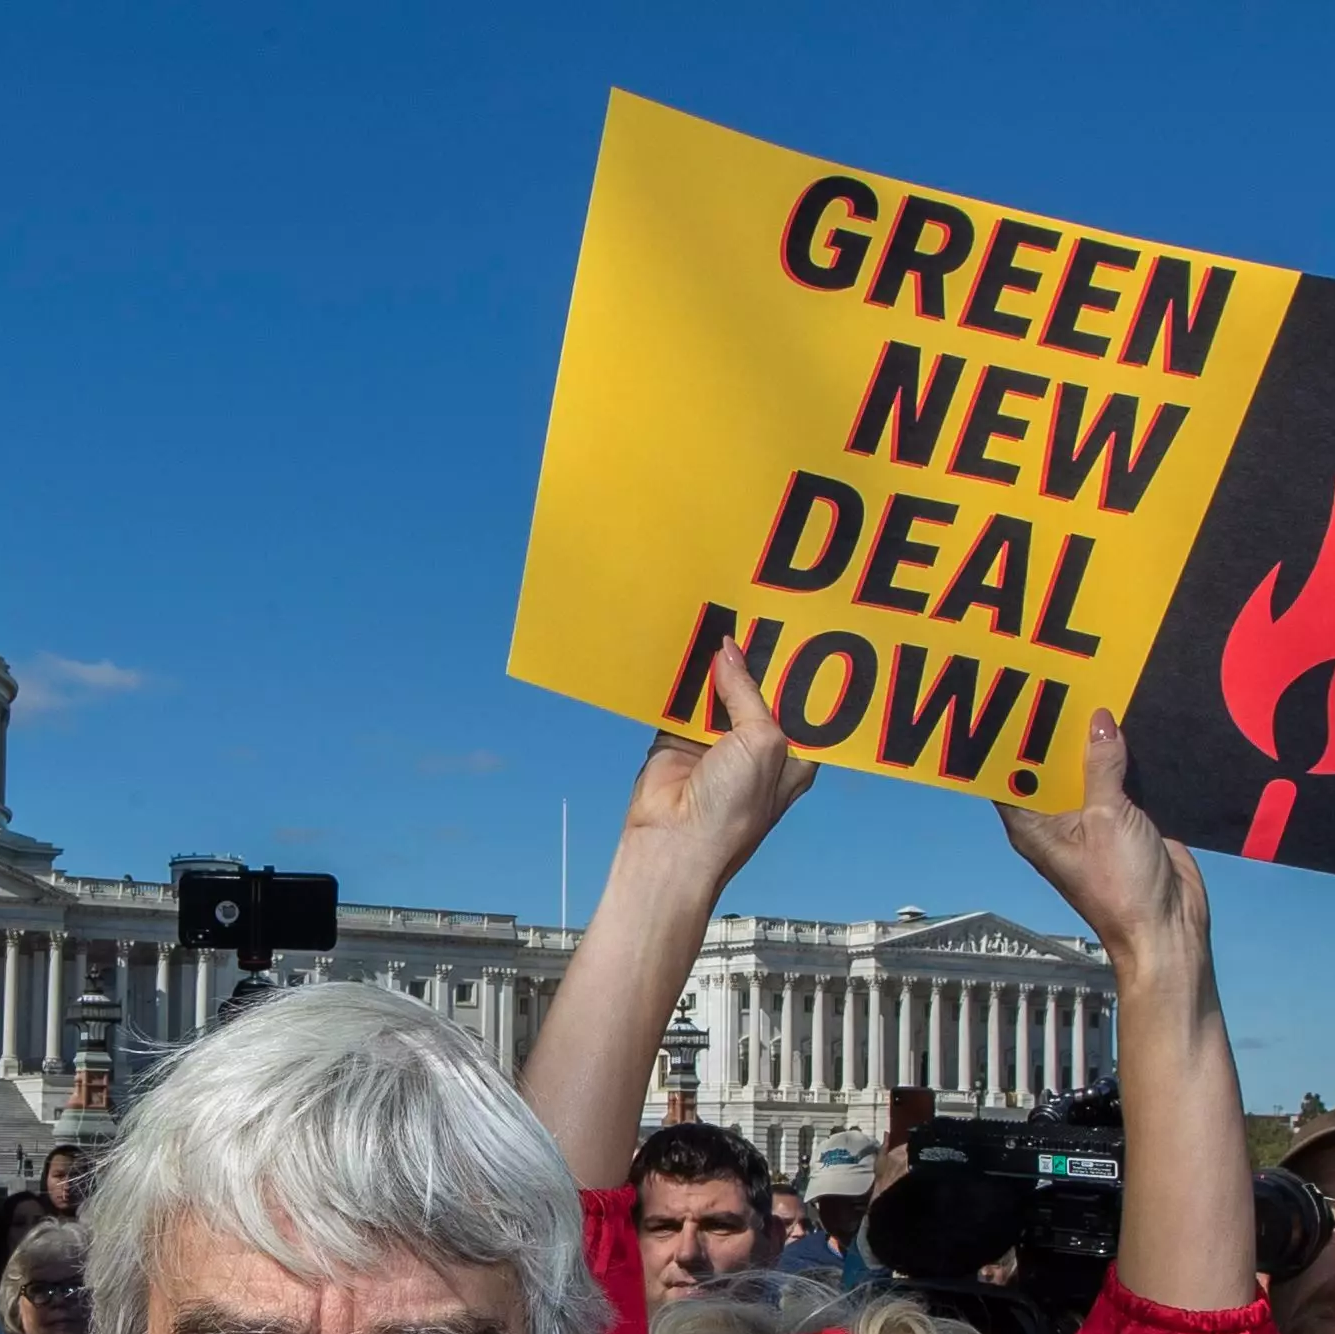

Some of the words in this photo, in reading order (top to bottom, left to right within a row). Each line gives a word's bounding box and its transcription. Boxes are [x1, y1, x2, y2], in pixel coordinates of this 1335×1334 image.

[779, 175, 1237, 380] GREEN
[842, 339, 1191, 517] NEW
[750, 469, 1101, 660] DEAL
[663, 602, 1070, 800] NOW!
